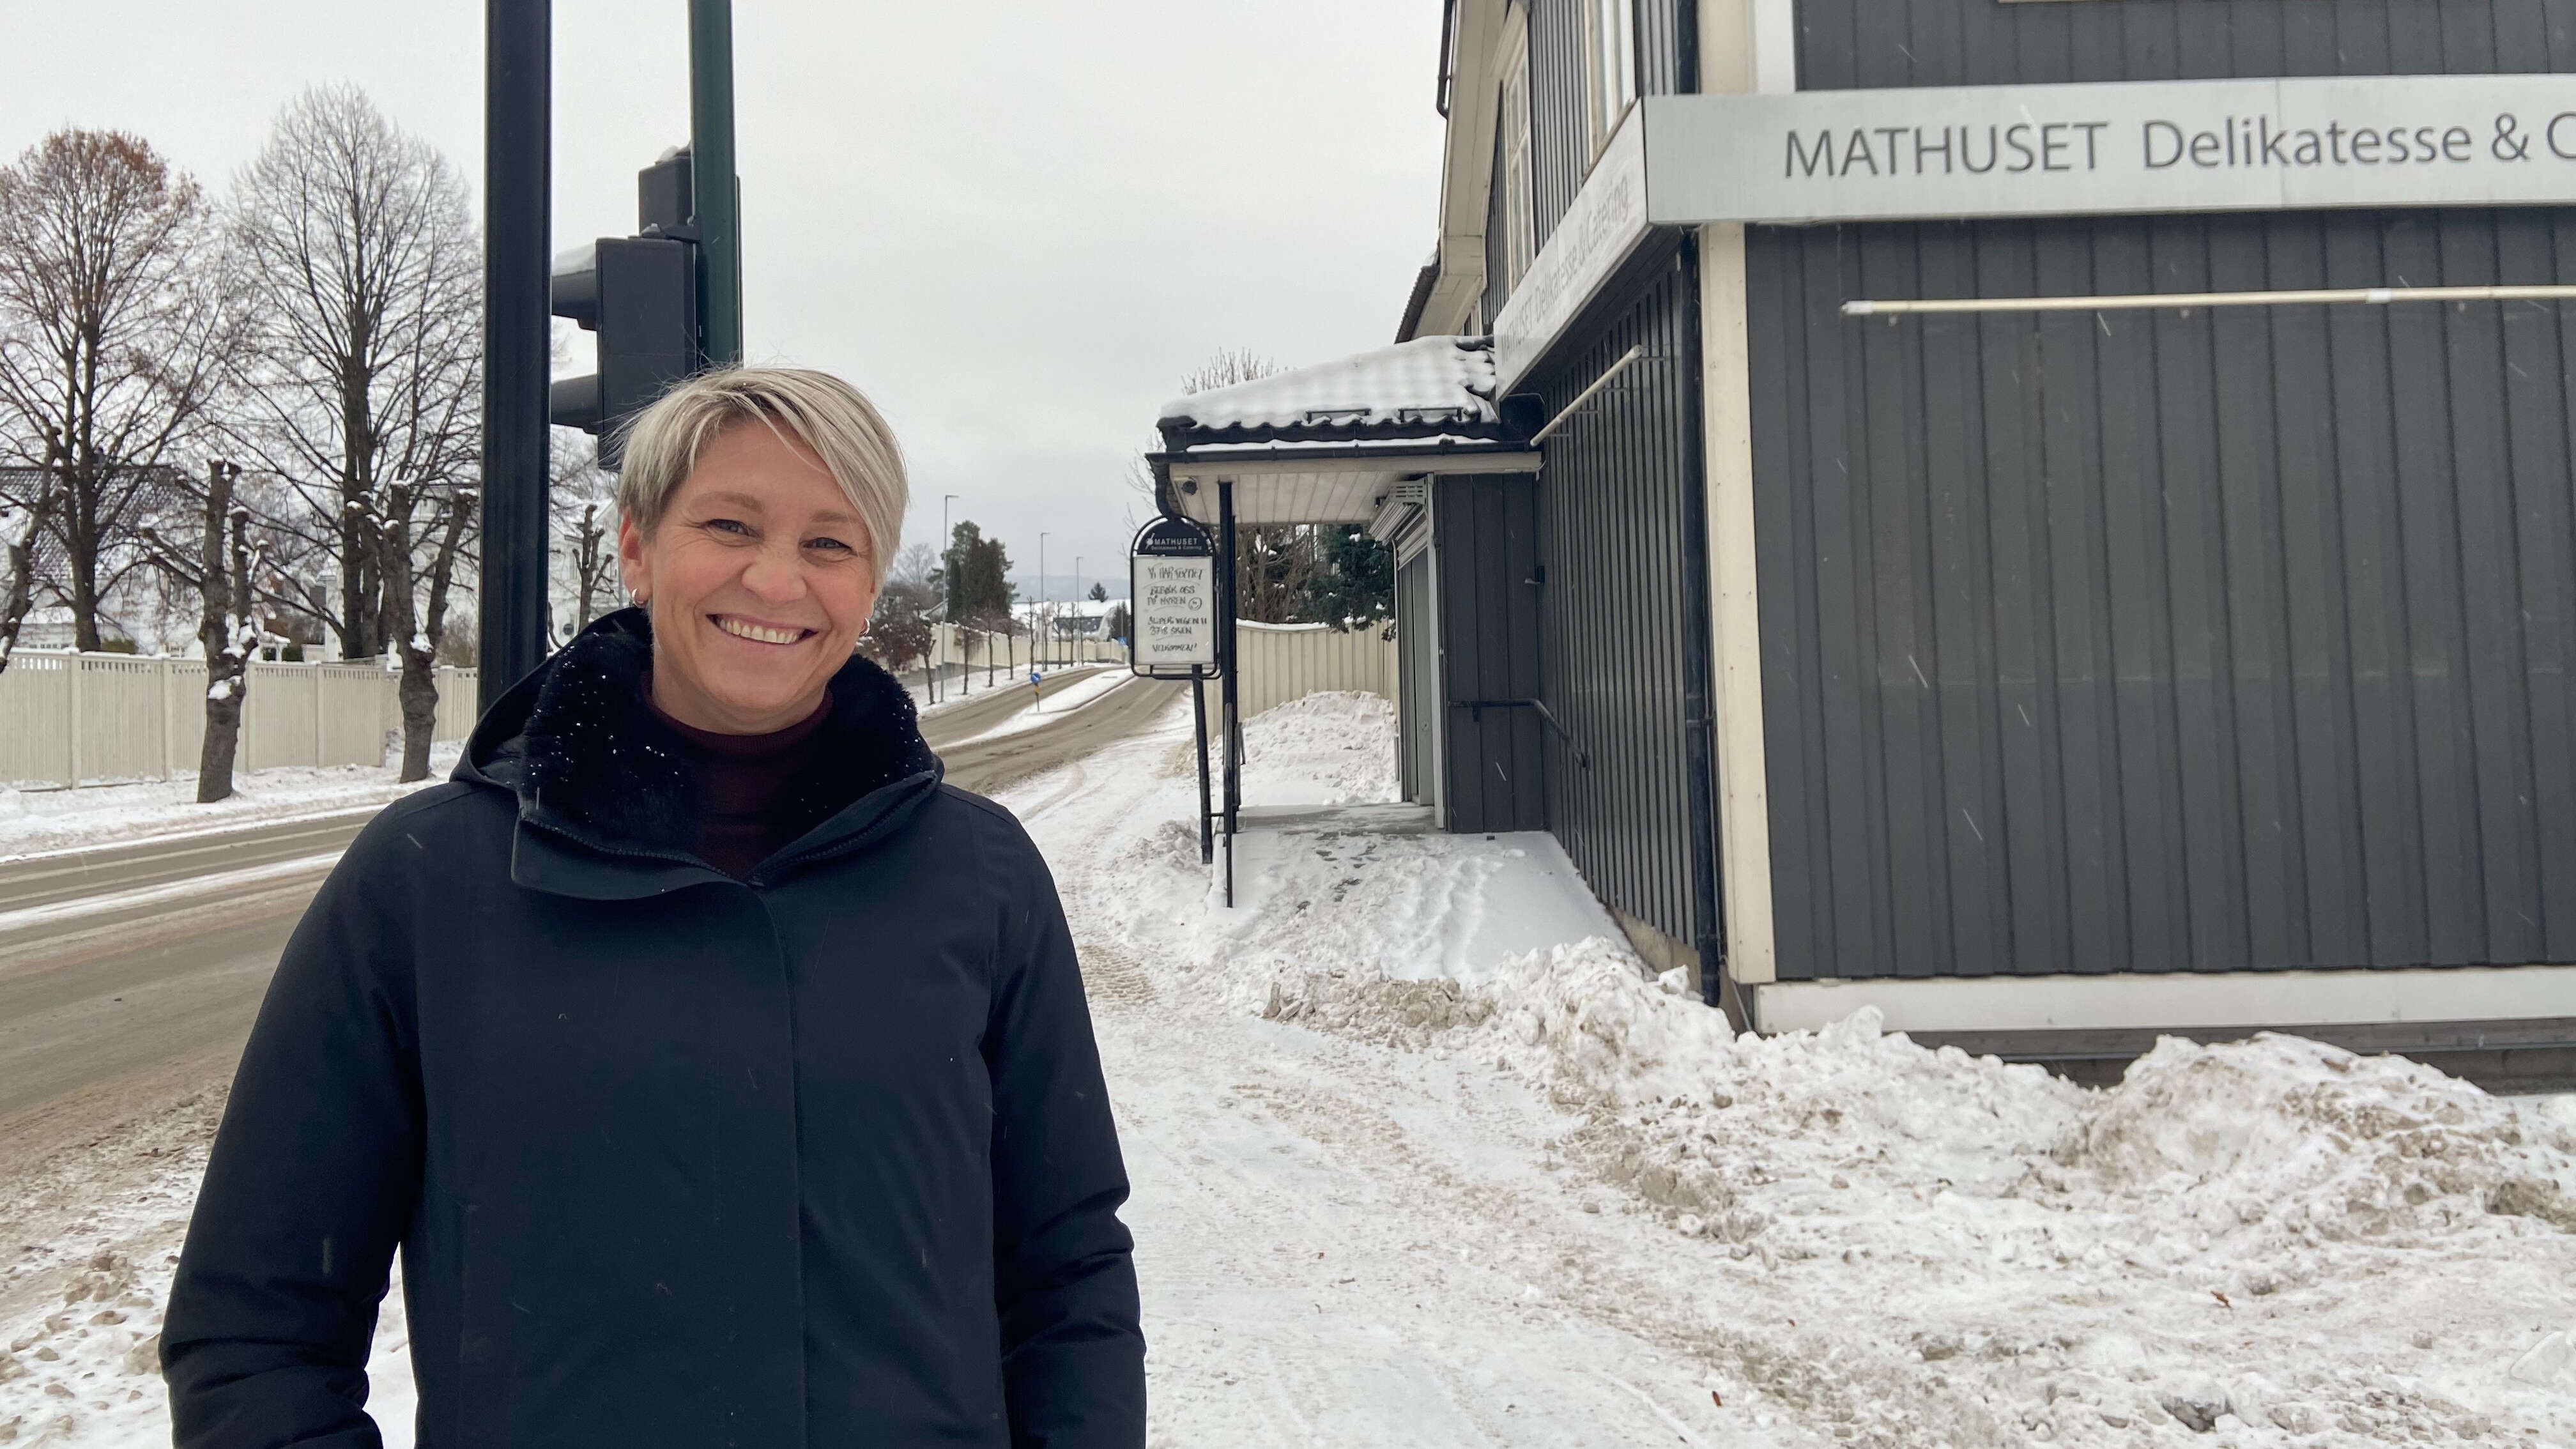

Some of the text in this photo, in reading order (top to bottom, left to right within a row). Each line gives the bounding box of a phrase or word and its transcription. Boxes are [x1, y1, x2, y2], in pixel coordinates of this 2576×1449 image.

[1786, 121, 2108, 178] MATHUSET
[2143, 115, 2471, 169] Delikatesse
[2492, 112, 2530, 161] &
[1587, 174, 1629, 254] Catering
[1154, 537, 1198, 546] MATHUSET
